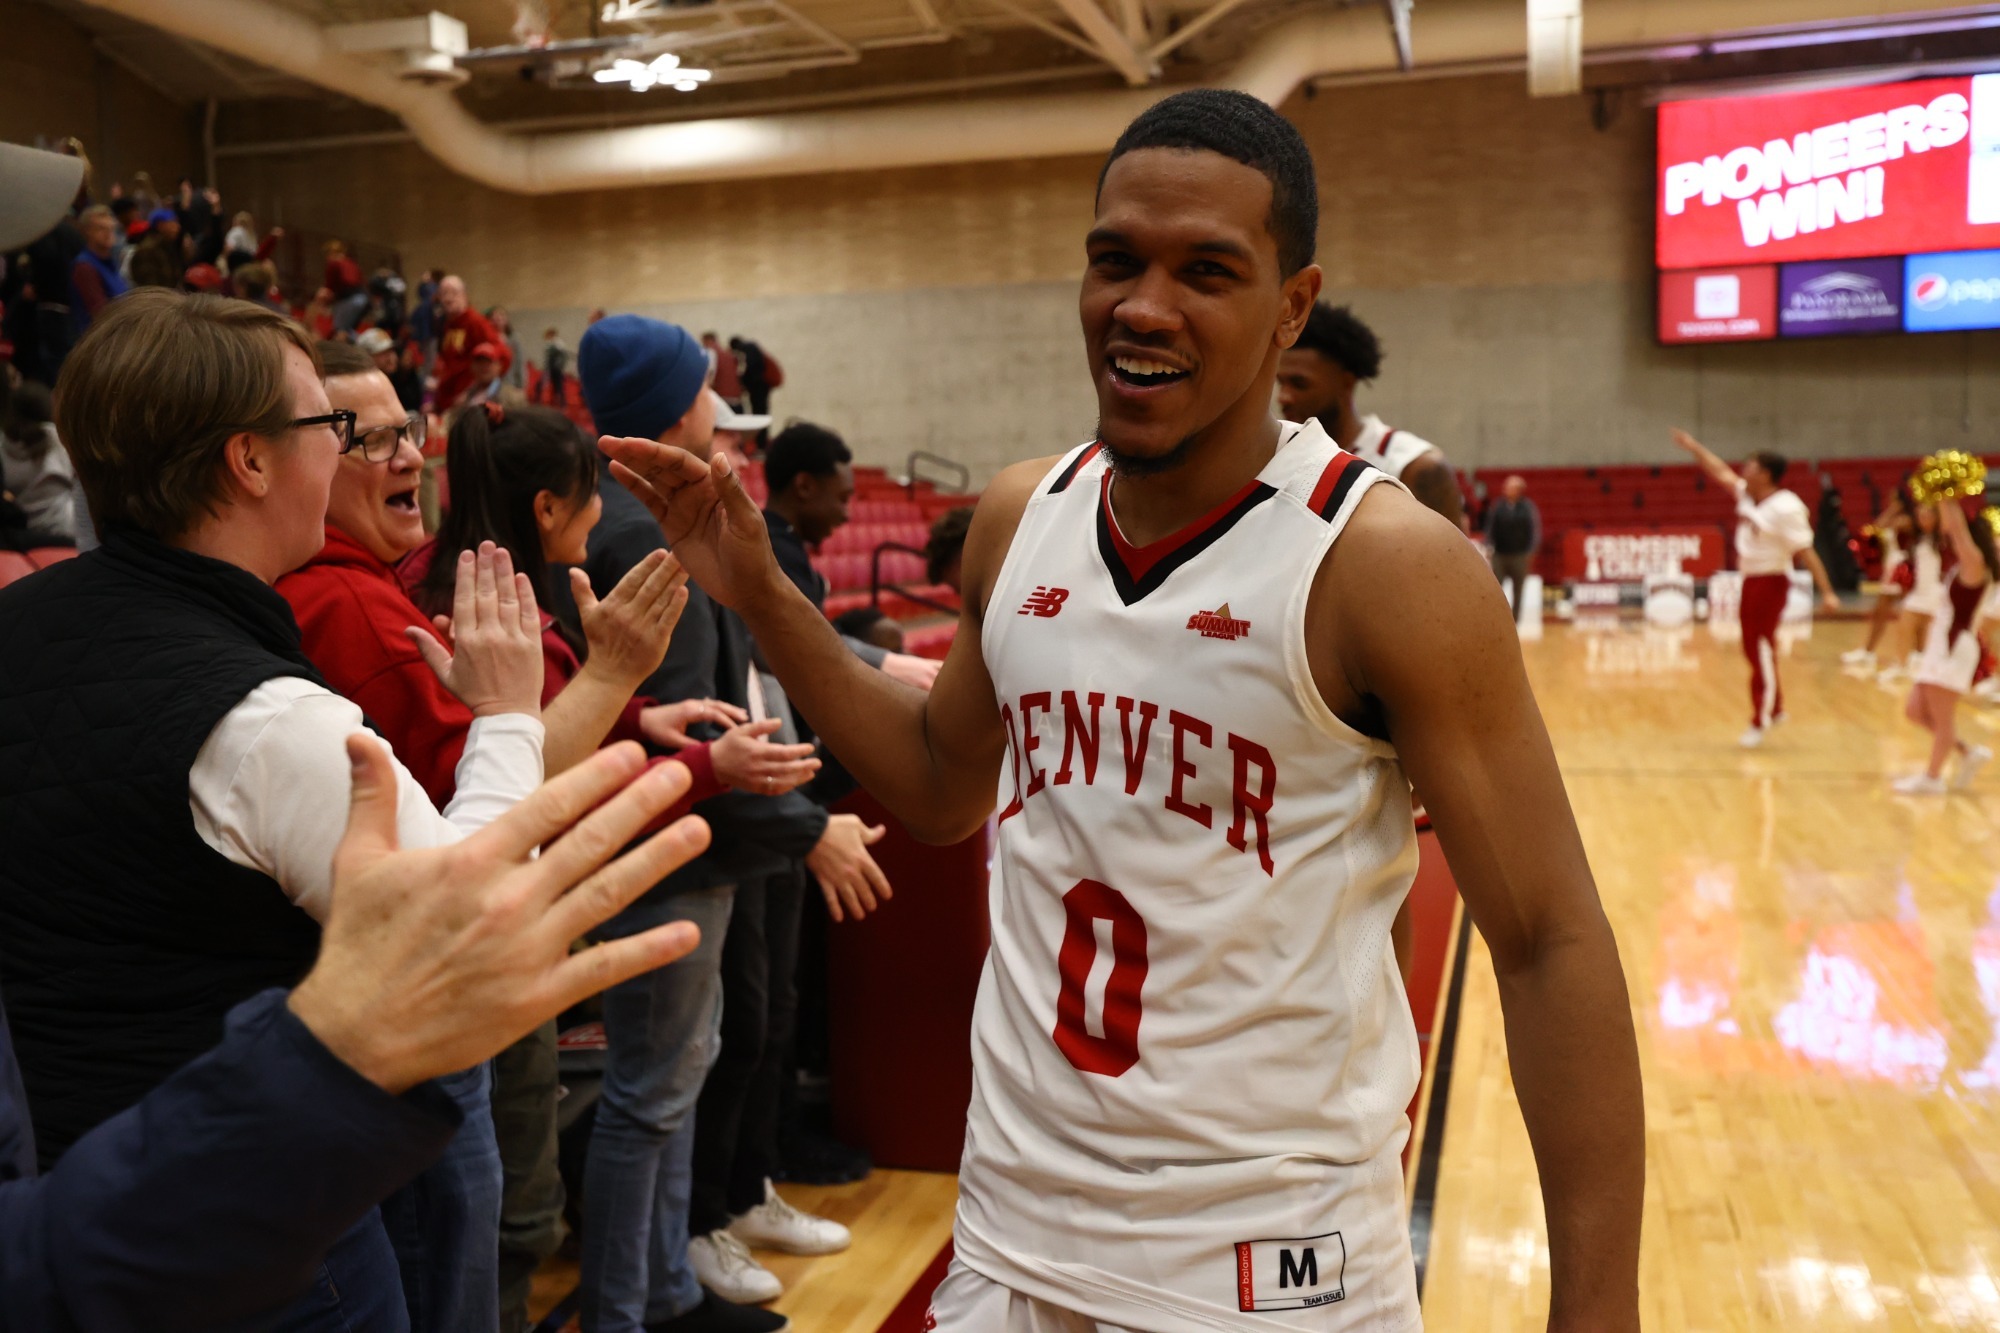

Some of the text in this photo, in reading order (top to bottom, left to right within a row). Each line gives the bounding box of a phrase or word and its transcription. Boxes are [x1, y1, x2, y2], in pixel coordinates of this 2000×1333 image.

[1665, 93, 1969, 215] PIONEERS
[1737, 166, 1885, 247] WIN!
[1584, 535, 1701, 560] CRIMSON
[1186, 614, 1251, 637] SUMMIT
[1201, 630, 1237, 641] LEAGUE
[1052, 878, 1149, 1078] 0
[1241, 1245, 1251, 1307] new balance
[1279, 1247, 1318, 1288] M
[1302, 1291, 1342, 1306] TEAM ISSUE
